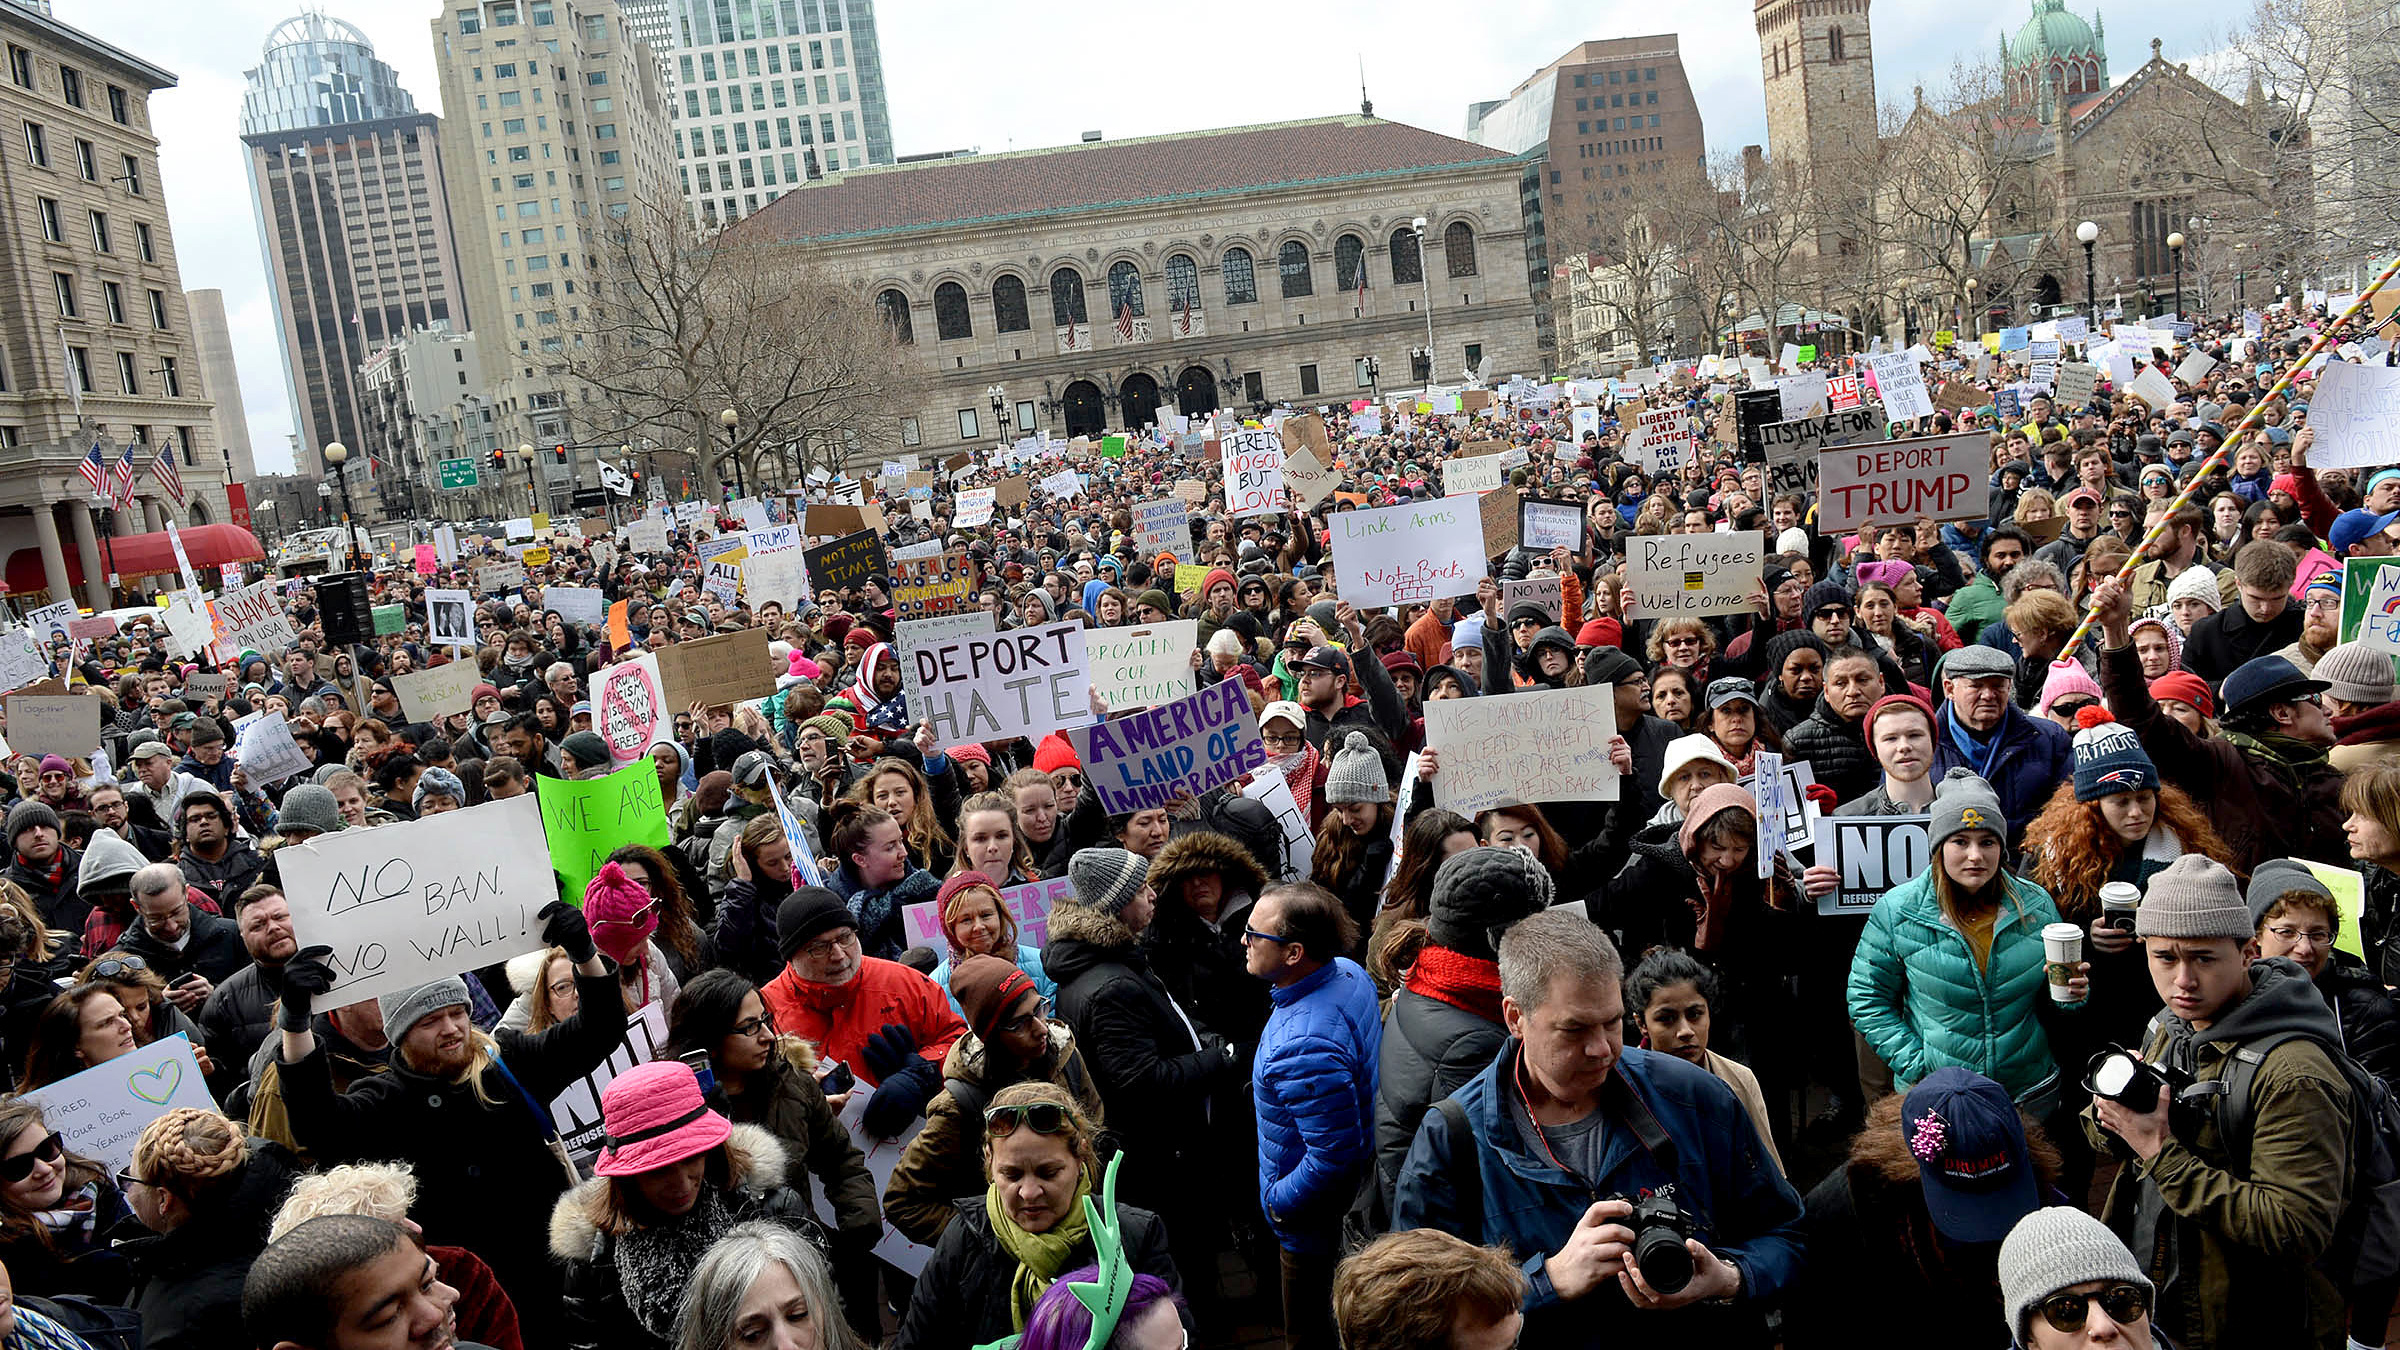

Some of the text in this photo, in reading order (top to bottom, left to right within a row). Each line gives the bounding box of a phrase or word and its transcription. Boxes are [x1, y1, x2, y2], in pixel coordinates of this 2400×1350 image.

[1639, 408, 1685, 426] LIBERTY
[1651, 421, 1676, 434] AND
[1794, 414, 1840, 441] TIME
[1841, 411, 1877, 433] FOR
[1221, 432, 1264, 459] THERE
[1263, 431, 1278, 451] IS
[1642, 430, 1689, 447] JUSTICE
[1655, 446, 1678, 459] FOR
[1658, 456, 1680, 469] ALL
[1857, 446, 1950, 477] DEPORT
[443, 470, 474, 479] New York
[1230, 455, 1250, 476] NO
[1450, 459, 1487, 473] NO BAN
[1239, 470, 1272, 491] BUT
[1452, 474, 1497, 491] NO WALL
[1230, 488, 1285, 513] LOVE
[1830, 473, 1970, 519] TRUMP
[1409, 511, 1457, 531] Arms
[1528, 515, 1577, 527] IMMIGRANTS
[1560, 509, 1572, 517] ALL
[748, 527, 791, 549] TRUMP
[1146, 530, 1176, 544] UNJUST
[820, 536, 876, 568] NOT THIS
[1645, 541, 1756, 575] Refugees
[220, 562, 242, 576] LOVE
[709, 562, 739, 581] ALL
[825, 555, 880, 585] TIME
[897, 554, 971, 580] AMERICA
[1364, 558, 1465, 587] Not Bricks
[895, 577, 972, 602] OPPORTUNITY
[1512, 585, 1533, 598] NO
[1641, 590, 1744, 610] Welcome
[30, 604, 71, 624] TIME
[222, 588, 281, 632] SHAME
[925, 595, 955, 612] NOT
[238, 632, 256, 648] ON
[917, 627, 1077, 687] DEPORT
[609, 668, 643, 690] TRUMP
[1115, 665, 1148, 682] OUR
[189, 683, 226, 693] SHAME!
[417, 682, 463, 704] MUSLIM
[607, 681, 645, 705] RACISM
[1099, 679, 1190, 706] ANCTUARY
[601, 690, 651, 720] MISOGYNY
[924, 669, 1088, 743] HATE
[1559, 694, 1601, 722] ALL
[600, 708, 660, 738] XENOPHOBIA
[1089, 677, 1251, 765] AMERICA
[613, 732, 648, 750] GREED
[1440, 725, 1592, 768] SUCCEED WHEN
[2075, 732, 2140, 766] PATRIOTS
[1118, 723, 1241, 788] LAND OF
[1096, 738, 1267, 815] IMMIGRANTS
[1442, 768, 1476, 800] HALF
[1487, 759, 1502, 782] OF
[1509, 757, 1531, 778] US
[1535, 753, 1571, 778] ARE
[1514, 776, 1562, 802] HELD
[552, 769, 661, 832] WE ARE
[1841, 824, 1930, 889] NO
[326, 857, 414, 913] NO
[329, 942, 387, 978] NO
[60, 1109, 132, 1141] YOUR POOR
[87, 1125, 146, 1151] YEARNING
[1654, 1182, 1676, 1198] MFS
[1656, 1211, 1677, 1221] Canon
